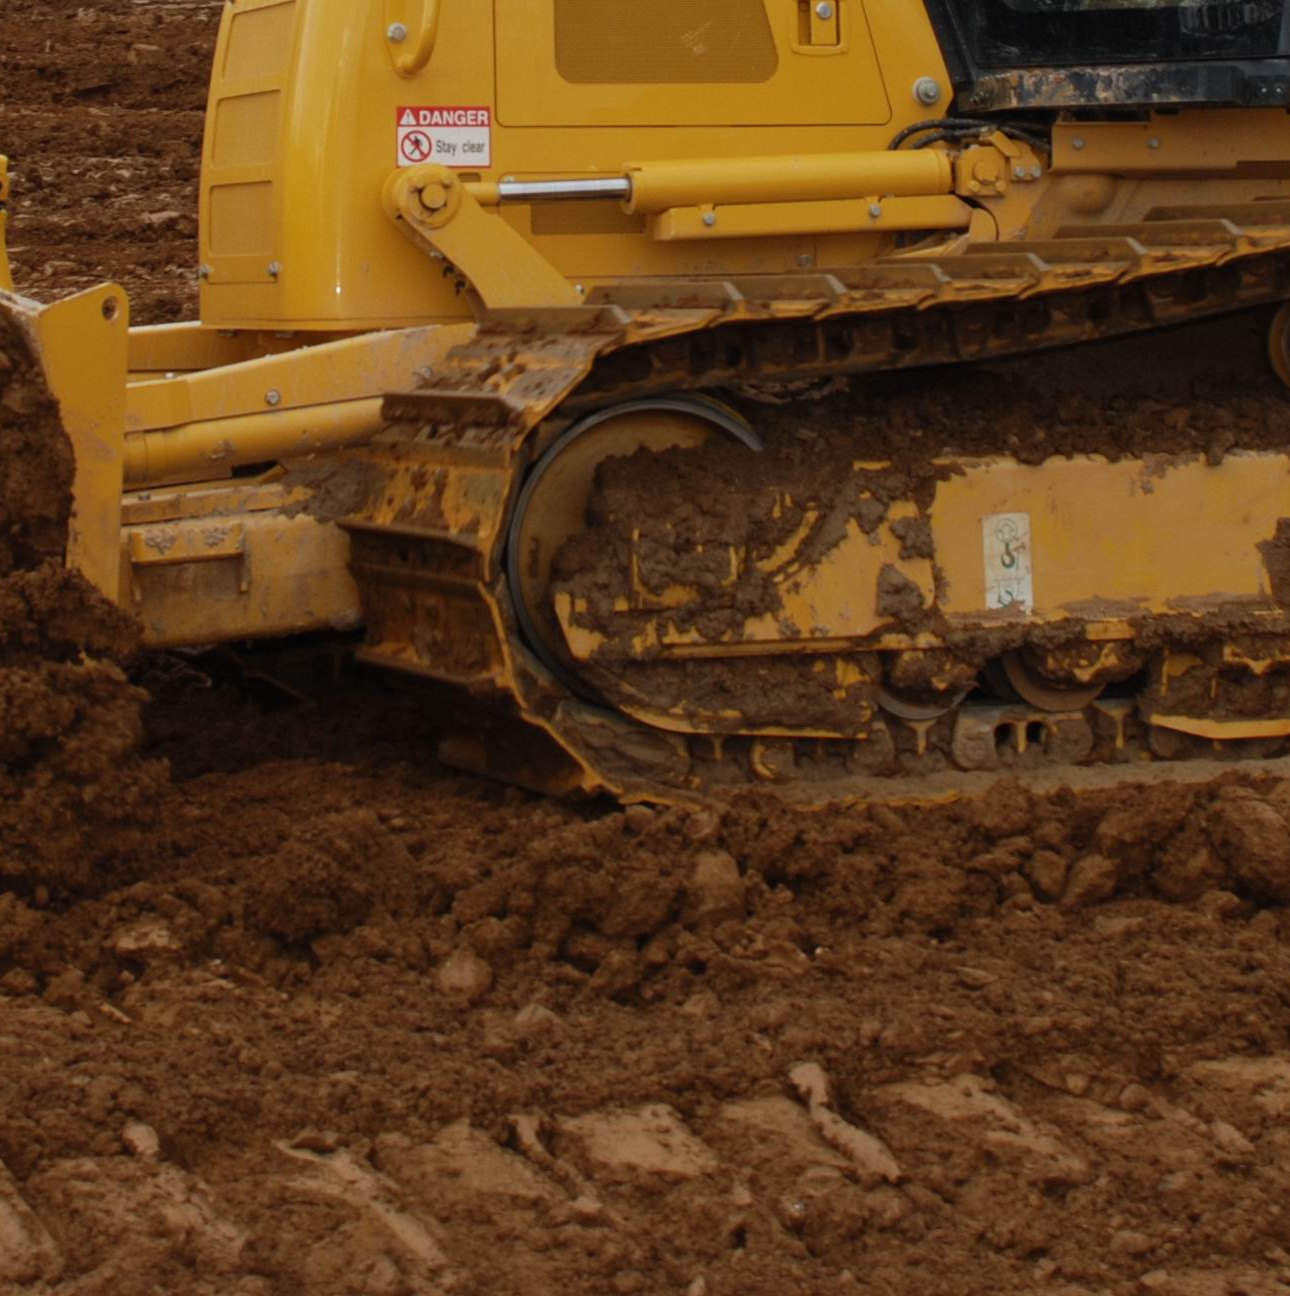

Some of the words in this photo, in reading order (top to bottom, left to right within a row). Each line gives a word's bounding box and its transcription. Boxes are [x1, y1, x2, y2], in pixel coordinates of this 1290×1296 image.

[419, 110, 489, 125] DANGER
[436, 140, 457, 156] Stay
[462, 140, 485, 153] clear
